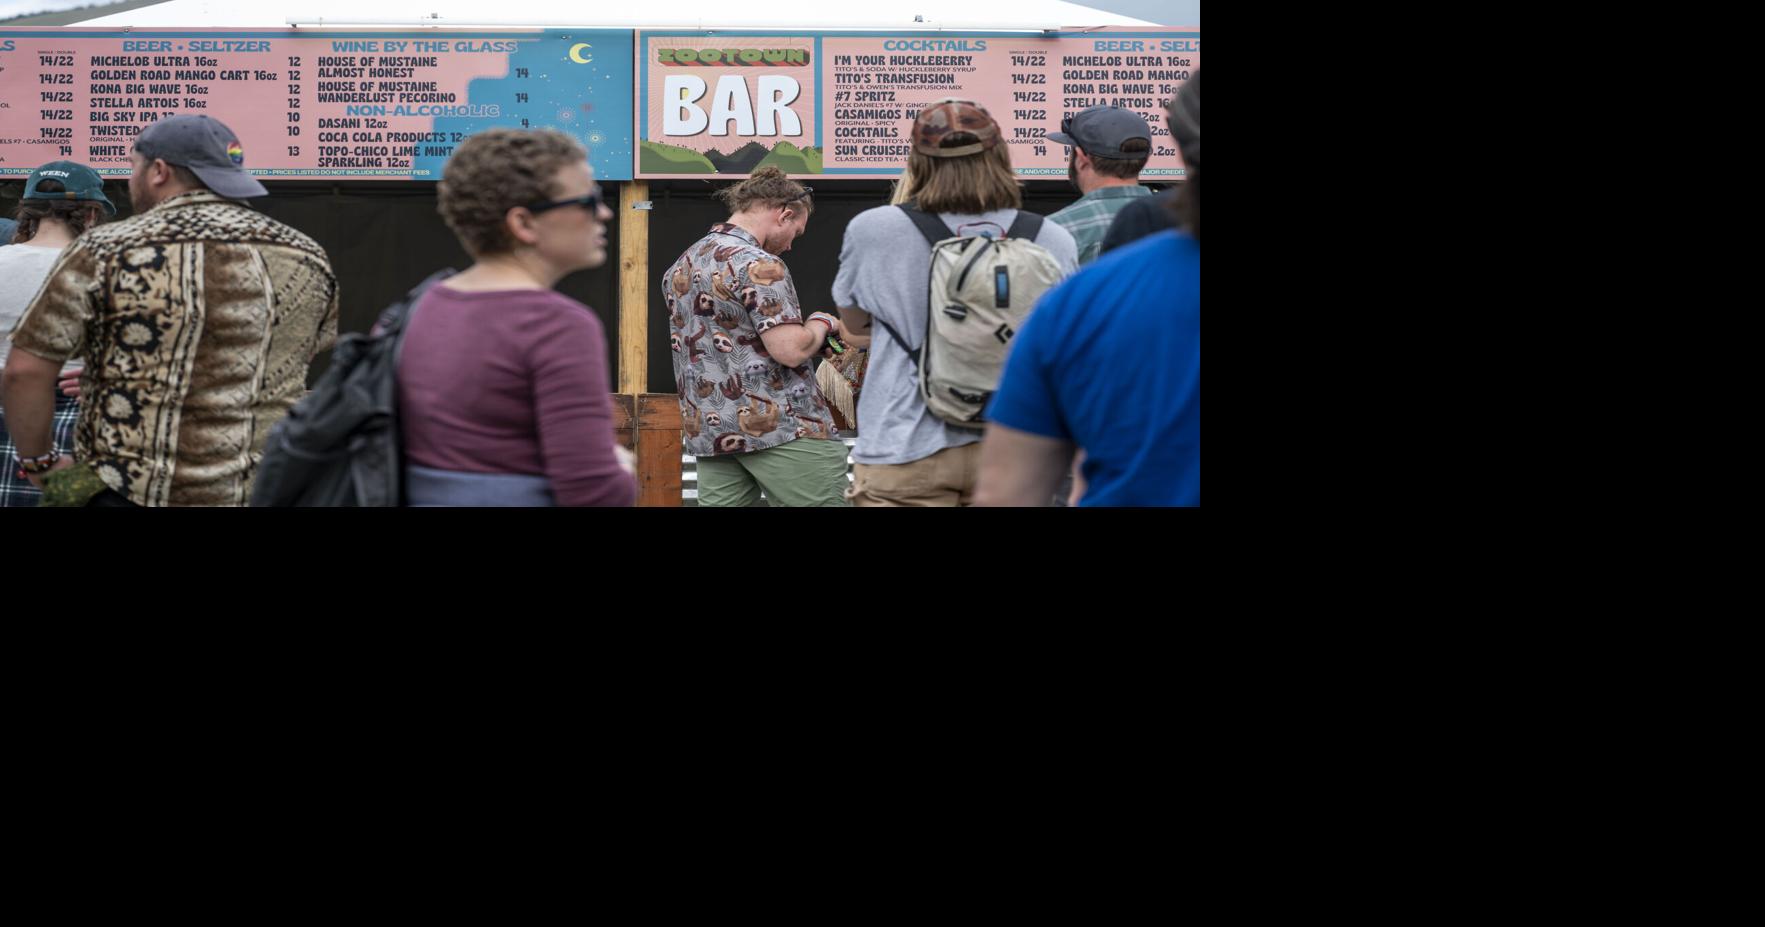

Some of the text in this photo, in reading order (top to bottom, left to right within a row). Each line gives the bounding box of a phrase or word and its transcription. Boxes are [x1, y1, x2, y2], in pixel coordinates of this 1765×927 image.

[123, 41, 271, 52] BEER SELTZER
[332, 41, 518, 52] WINE BY THE GLASS
[884, 40, 986, 51] COCKTAILS
[1094, 41, 1144, 52] BEER
[40, 56, 73, 66] 14/22
[91, 56, 300, 67] MICHELOB ULTRA 16oz 12
[318, 57, 437, 67] HOUSE OF MUSTAINE
[658, 49, 810, 67] ZOOTOWN
[835, 56, 1045, 66] I'M YOUR HUCKLEBERRY 14/22
[1063, 56, 1190, 66] MICHELOB ULTRA 16oz
[91, 70, 300, 81] GOLDEN ROAD MANGO CART 16oz 12
[318, 68, 528, 78] ALMOST HONEST 14
[1063, 70, 1189, 81] GOLDEN ROAD MANGO
[40, 74, 73, 84] 14/22
[835, 74, 1046, 84] TITO'S TRANSFUSION 14/22
[90, 84, 300, 94] KONA BIG WAVE 16oz 12
[318, 82, 437, 92] HOUSE OF MUSTAINE
[1064, 84, 1178, 94] KONA BIG WAVE 16o
[40, 92, 73, 102] 14/22
[318, 93, 528, 103] WANDERLUST PECORINO 14
[835, 92, 1046, 102] #7 SPRITZ 14/22
[90, 98, 300, 108] STELLA ARTOIS 16oz 12
[664, 74, 802, 137] BAR
[1112, 98, 1153, 108] ARTOIS
[41, 110, 72, 120] 14/22
[346, 105, 499, 117] NON-ALCOHOLIC
[835, 110, 901, 120] CASAMIGOS
[1014, 110, 1046, 120] 14/22
[90, 112, 109, 122] BIG
[114, 112, 135, 122] SKY
[140, 112, 158, 122] IPA
[287, 112, 300, 122] 10
[319, 119, 529, 128] DASANI 12oz 4
[40, 128, 72, 138] 14/22
[90, 126, 140, 136] TWISTED
[287, 126, 300, 136] 10
[835, 128, 1046, 138] COCKTAILS 14/22
[1151, 126, 1168, 136] 2oz
[319, 133, 348, 142] COCA
[353, 133, 382, 142] COLA
[387, 133, 446, 142] PRODUCTS
[59, 146, 72, 156] 14
[90, 146, 125, 156] WHITE
[288, 146, 300, 156] 13
[319, 146, 454, 156] TOPO-CHICO LIME MINT
[835, 146, 1046, 156] SUN CRUISER 14
[1150, 146, 1175, 156] .2oz
[318, 158, 409, 167] SPARKLING 12oz
